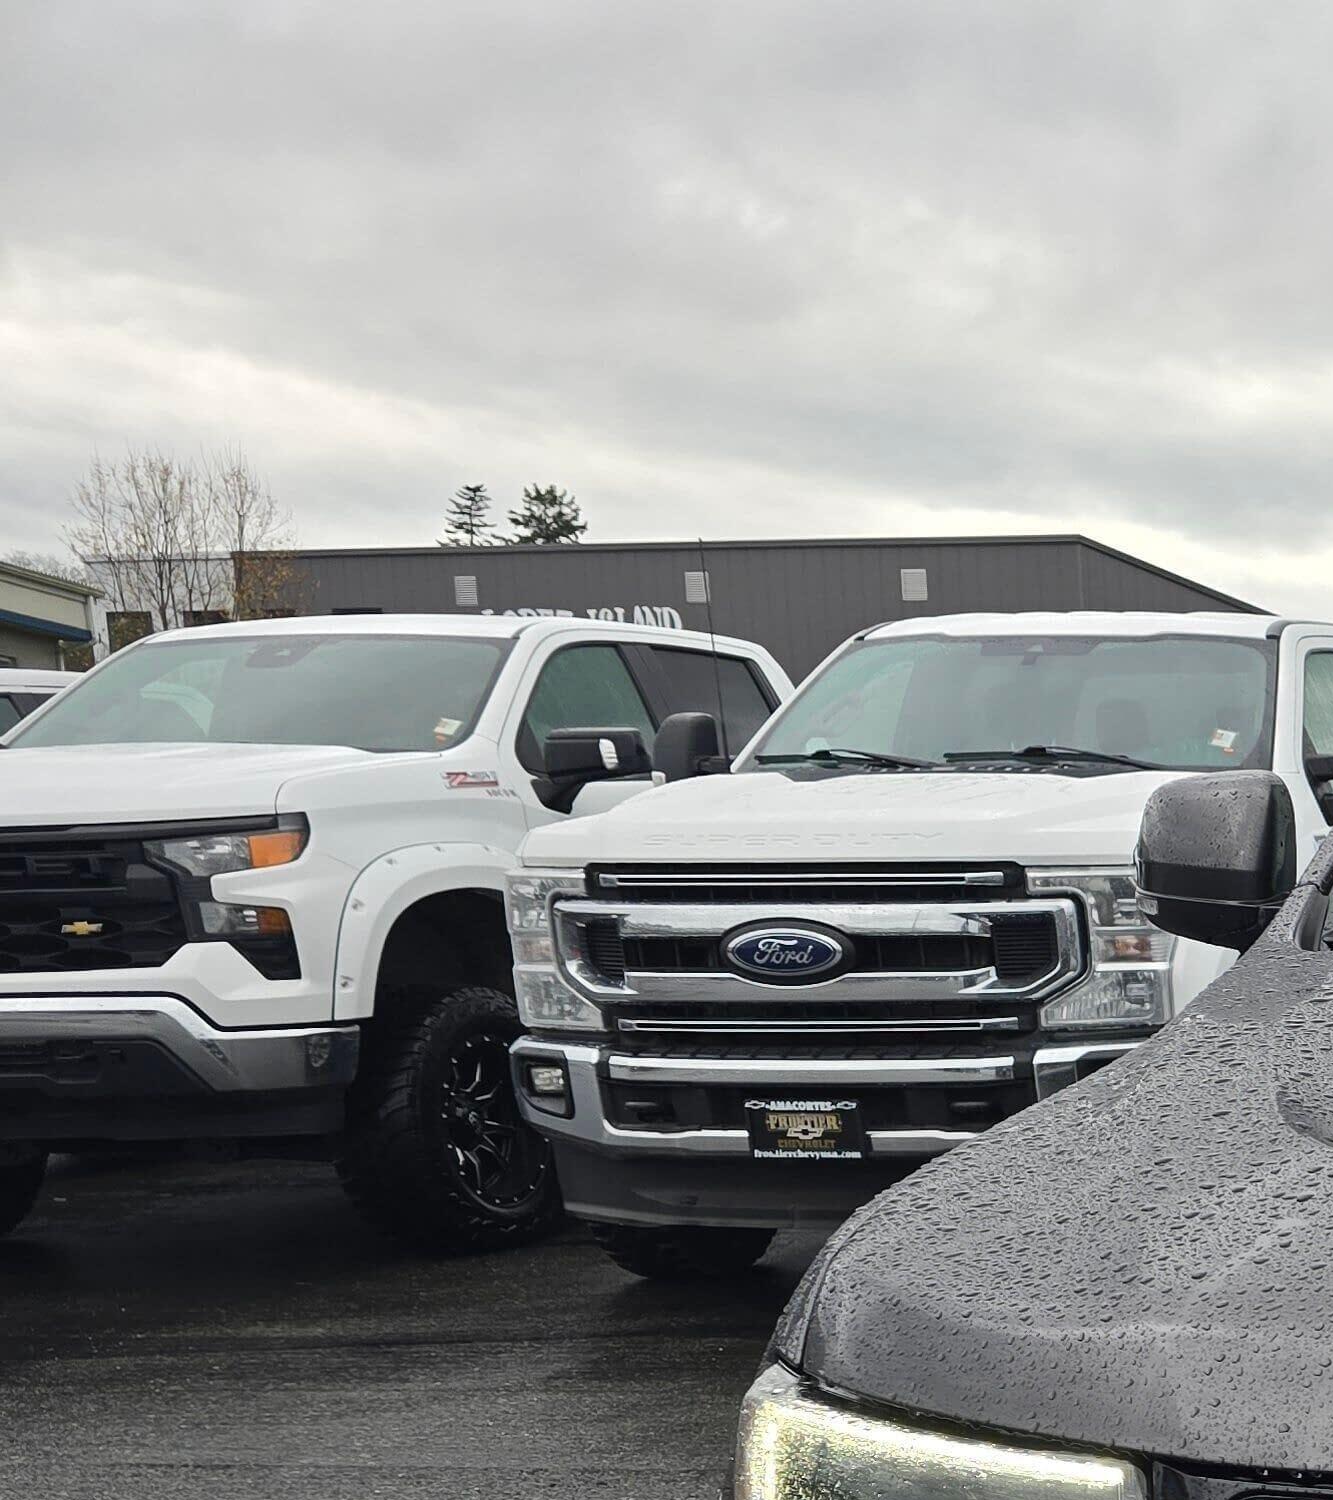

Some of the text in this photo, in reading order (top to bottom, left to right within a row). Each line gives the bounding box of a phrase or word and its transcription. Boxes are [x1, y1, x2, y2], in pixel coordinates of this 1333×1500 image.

[643, 831, 944, 847] SUPER DUTY
[753, 938, 814, 964] Ford
[769, 1101, 833, 1111] ANACORTES
